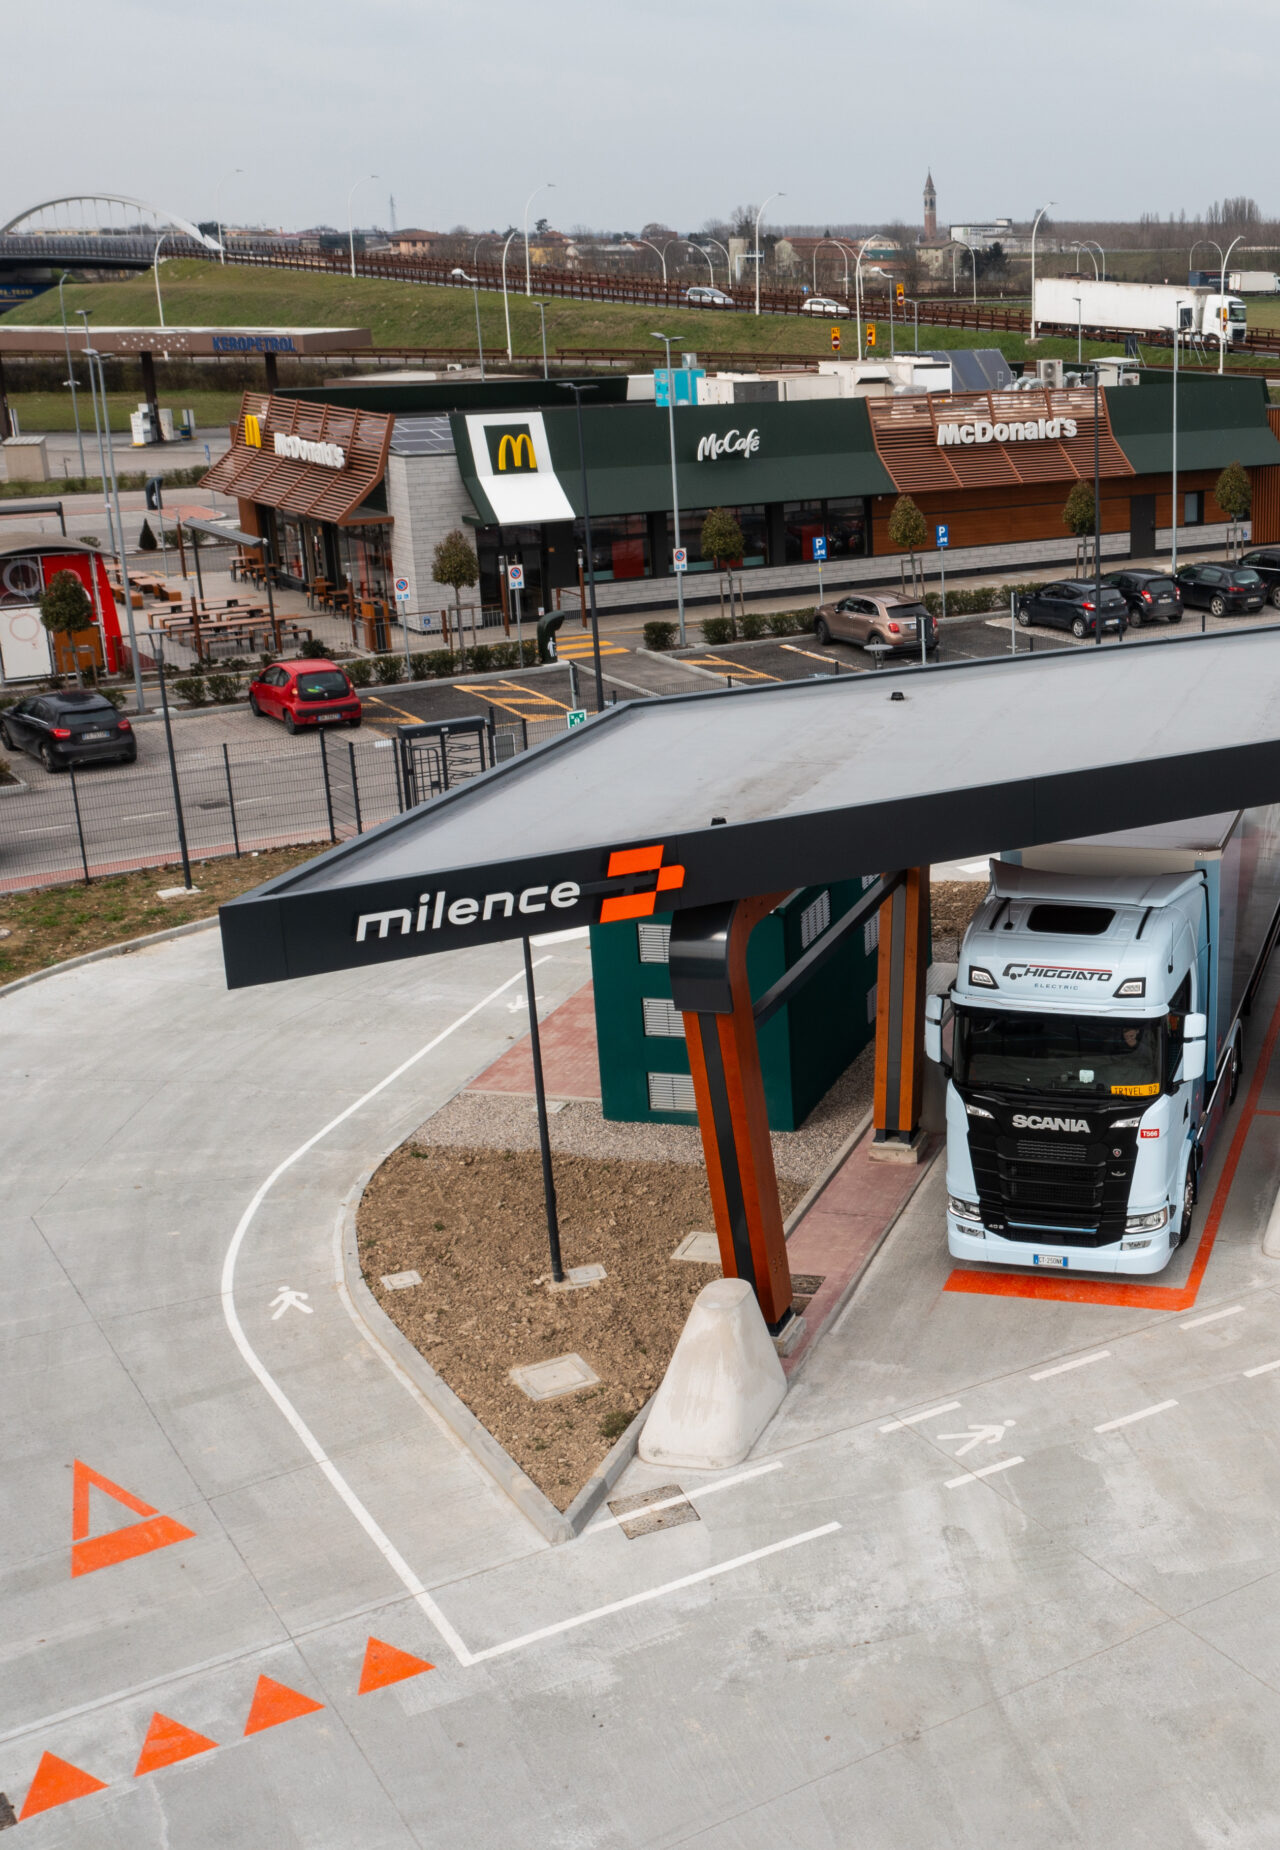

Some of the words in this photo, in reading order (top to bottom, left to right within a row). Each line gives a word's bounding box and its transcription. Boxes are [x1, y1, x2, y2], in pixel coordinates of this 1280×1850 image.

[212, 336, 297, 352] KEROPETROL
[937, 417, 1078, 446] McDonald's
[697, 428, 760, 461] McCafé
[938, 526, 946, 536] P
[815, 538, 823, 549] P
[355, 881, 581, 942] milence
[1002, 963, 1113, 982] CHIGGIATO
[1034, 983, 1079, 991] ELECTRIC
[1012, 1114, 1091, 1133] SCANIA
